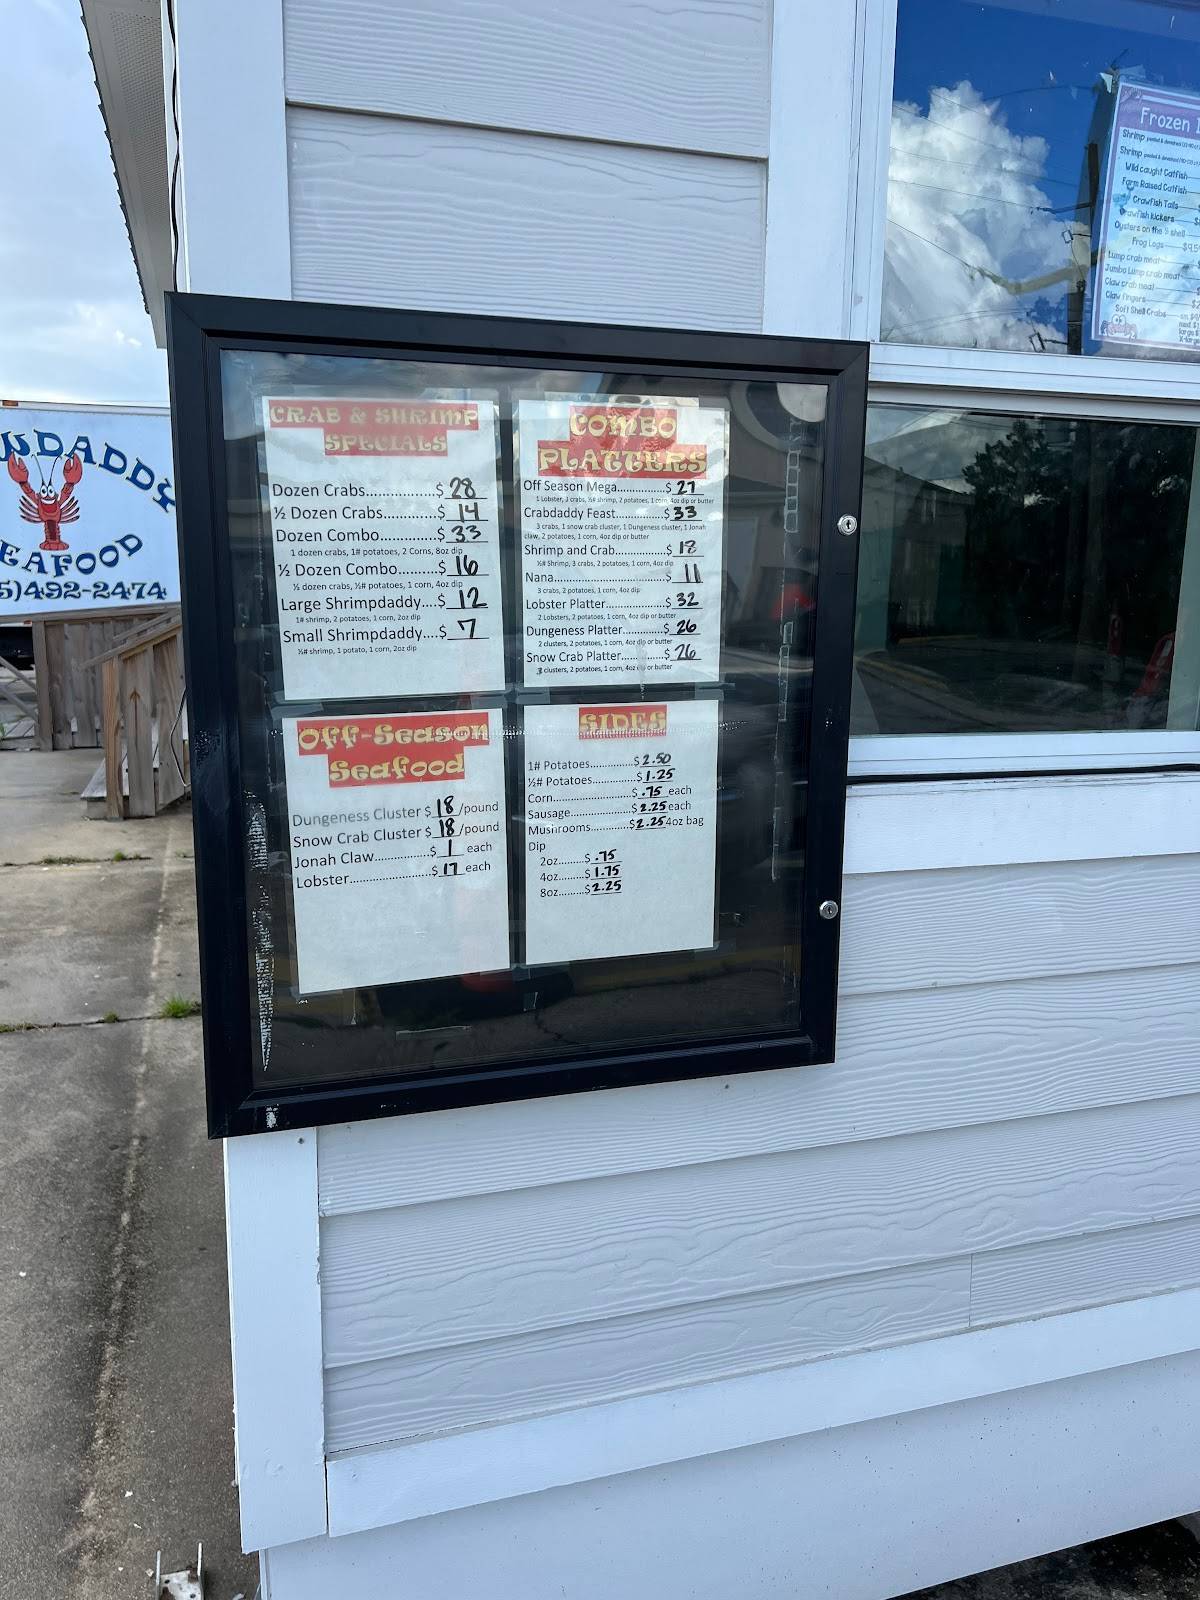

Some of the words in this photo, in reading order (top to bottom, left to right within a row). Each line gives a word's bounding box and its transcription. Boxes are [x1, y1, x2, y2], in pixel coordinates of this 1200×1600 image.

[1140, 107, 1190, 132] Frozen
[1122, 129, 1145, 142] Shrimp
[1120, 146, 1142, 158] Shrimp
[270, 406, 341, 423] CRAB
[351, 407, 367, 425] &
[375, 408, 478, 426] SHRIMP
[570, 413, 677, 438] COMBO
[325, 434, 447, 452] SPECIALS
[539, 448, 707, 473] PLATTERS
[272, 483, 319, 497] Dozen
[523, 480, 543, 491] Off
[544, 480, 583, 493] Season
[291, 506, 340, 520] Dozen
[524, 507, 584, 521] Crabdaddy
[276, 529, 322, 542] Dozen
[325, 549, 348, 557] crabs,
[363, 548, 400, 557] potatoes,
[524, 544, 564, 557] Shrimp
[567, 545, 587, 556] and
[295, 563, 341, 577] Dozen
[543, 587, 561, 595] crabs,
[568, 587, 596, 595] potatoes,
[630, 586, 641, 594] dip
[281, 598, 321, 613] Large
[526, 599, 568, 610] Lobster
[305, 615, 332, 624] shrimp,
[339, 614, 372, 623] potatoes,
[410, 614, 421, 622] dip
[543, 613, 571, 621] Lobsters,
[578, 613, 606, 621] potatoes,
[283, 630, 323, 644] Small
[526, 625, 585, 638] Dungeness
[526, 651, 556, 663] Snow
[559, 651, 583, 662] Crab
[579, 711, 667, 735] SIDES
[298, 722, 489, 750] Off-Season
[330, 752, 465, 782] Seafood
[528, 761, 540, 771] 1#
[668, 785, 692, 795] each
[668, 800, 691, 811] each
[292, 813, 370, 828] Dungeness
[374, 807, 421, 821] Cluster
[666, 816, 683, 827] 4oz
[686, 815, 704, 827] bag
[293, 833, 333, 848] Snow
[337, 832, 369, 844] Crab
[374, 827, 422, 842] Cluster
[528, 841, 546, 853] Dip
[294, 855, 336, 870] Jonah
[467, 842, 492, 853] each
[465, 861, 491, 873] each
